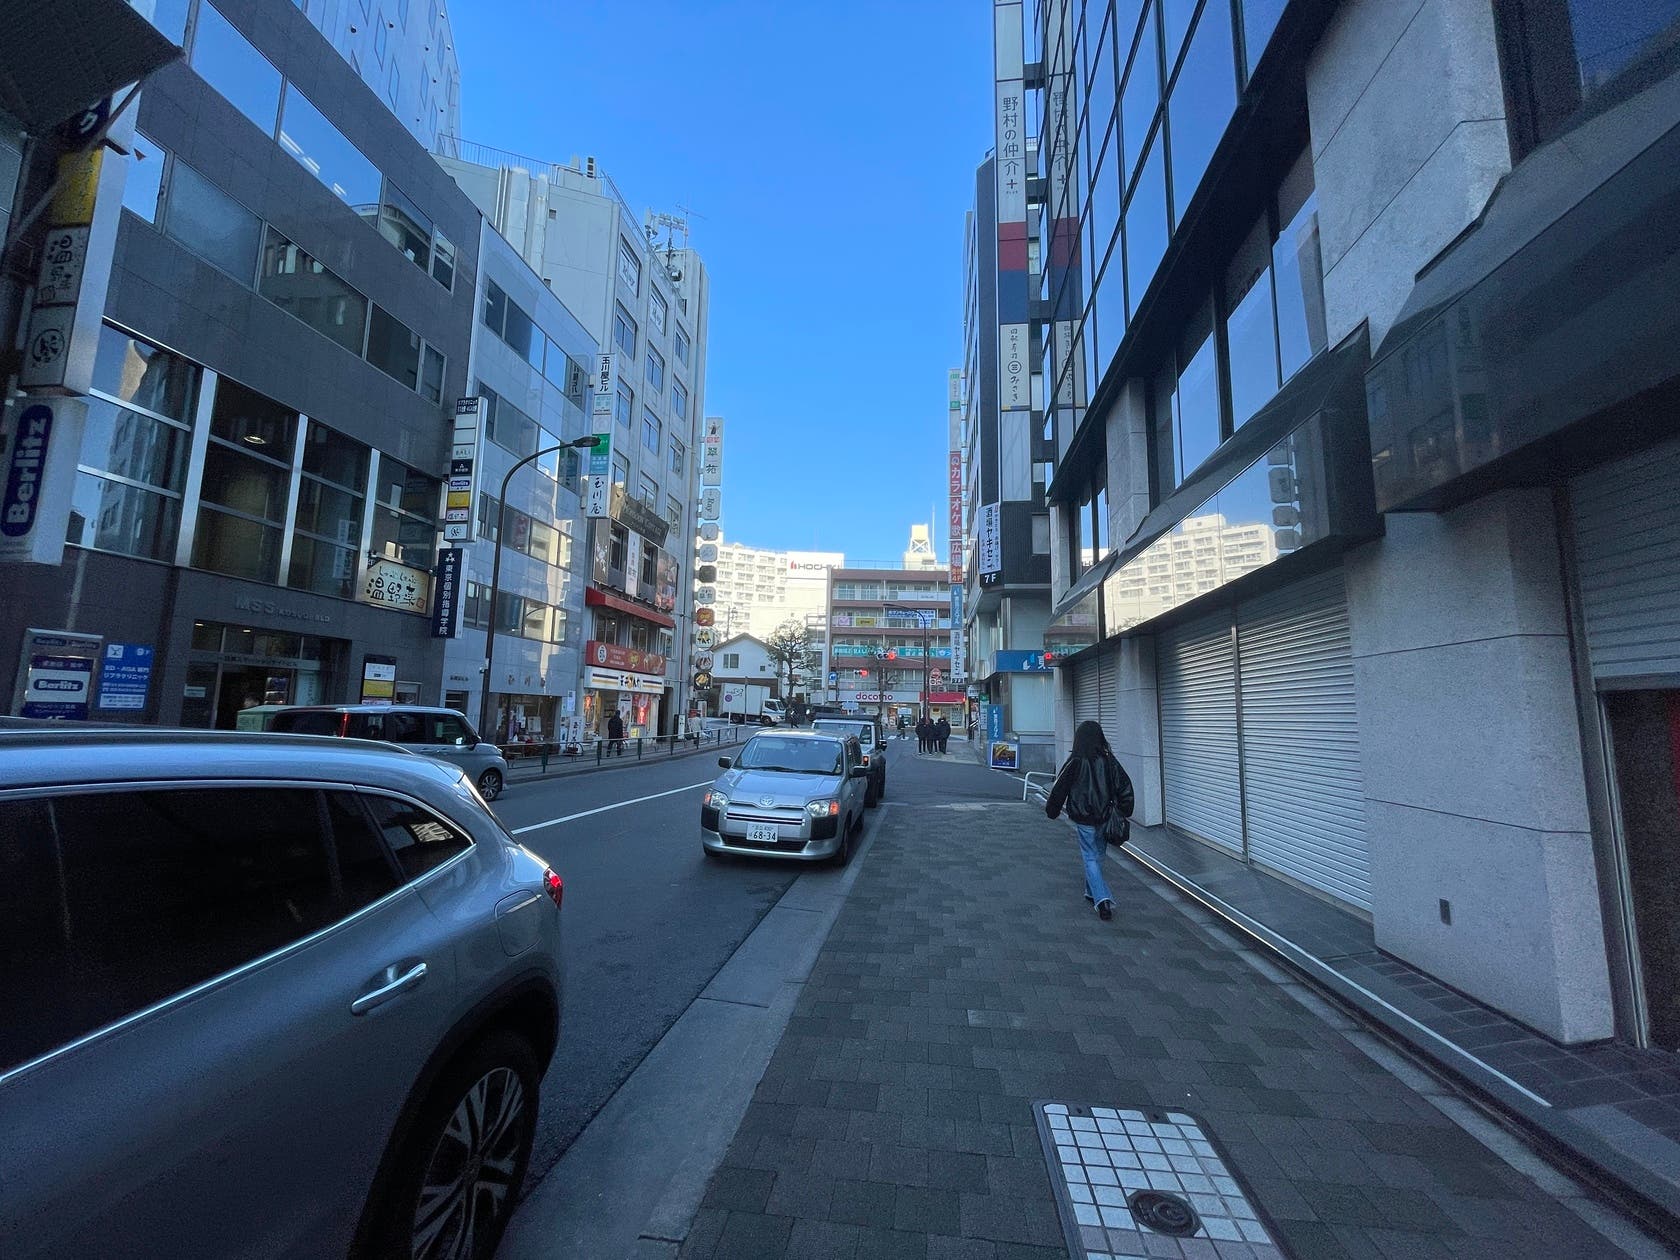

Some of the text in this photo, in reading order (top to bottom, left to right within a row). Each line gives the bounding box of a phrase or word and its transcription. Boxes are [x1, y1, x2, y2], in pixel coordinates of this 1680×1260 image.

[7, 418, 46, 523] Berlitz
[798, 563, 840, 571] HOCHKI
[985, 573, 996, 584] 7F
[439, 564, 453, 635] 東京個別指導学院
[38, 681, 79, 690] Berlitz
[856, 692, 893, 701] docomo
[753, 831, 776, 841] 68-34
